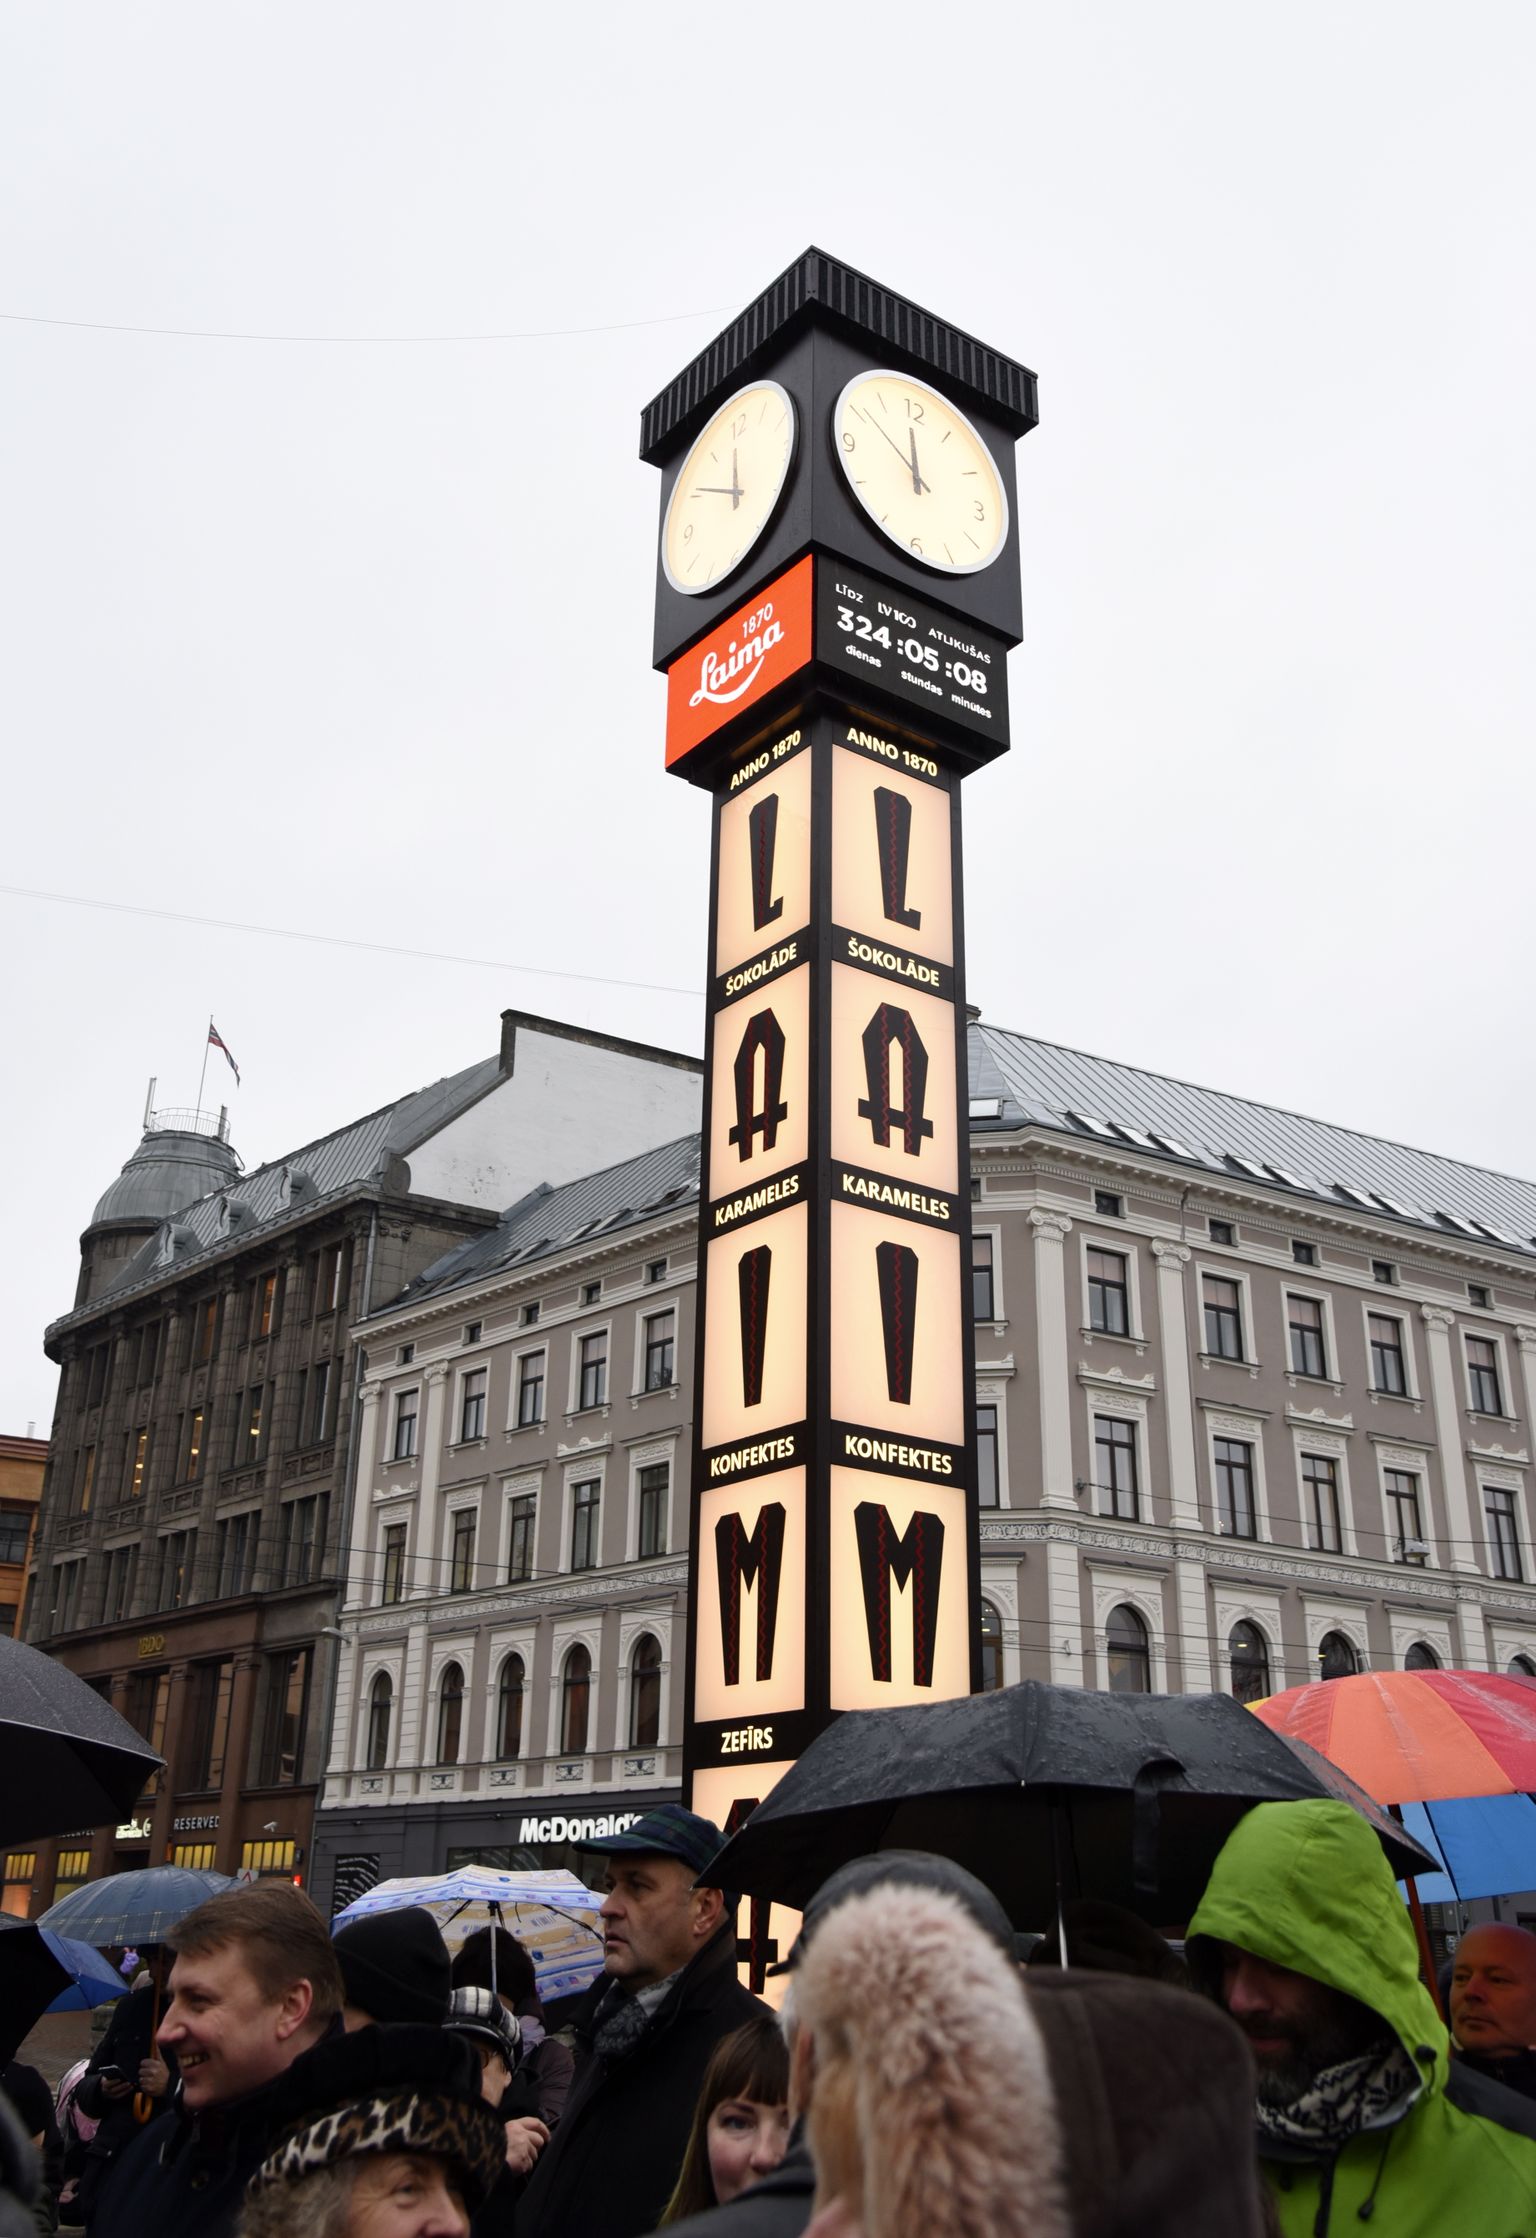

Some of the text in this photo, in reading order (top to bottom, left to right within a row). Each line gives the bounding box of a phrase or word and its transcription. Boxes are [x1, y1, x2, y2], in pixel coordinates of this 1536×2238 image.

[726, 412, 746, 440] 12
[903, 398, 925, 425] 12
[842, 432, 856, 453] 9
[683, 523, 694, 547] 9
[973, 499, 985, 522] 3
[742, 602, 774, 639] 1870
[836, 583, 864, 603] LĪDZ
[928, 627, 991, 665] ATLIKUŠAS
[837, 605, 892, 650] 324
[689, 620, 784, 707] Laima
[845, 643, 882, 668] dienas
[901, 669, 943, 696] stundas
[730, 729, 801, 791] ANNO 1870
[847, 727, 938, 777] ANNO 1870
[749, 792, 784, 932] L
[873, 785, 922, 931] L
[725, 942, 797, 997] ŠOKOLĀDE
[847, 937, 940, 987] ŠOKOLĀDE
[728, 1007, 788, 1163] A
[857, 1002, 934, 1157] A
[715, 1174, 799, 1227] KARAMELES
[842, 1173, 950, 1220] KARAMELES
[710, 1435, 795, 1477] KONFEKTES
[845, 1434, 953, 1475] KONFEKTES
[715, 1501, 787, 1687] M
[853, 1501, 946, 1688] M
[720, 1725, 773, 1754] ZEFĪRS
